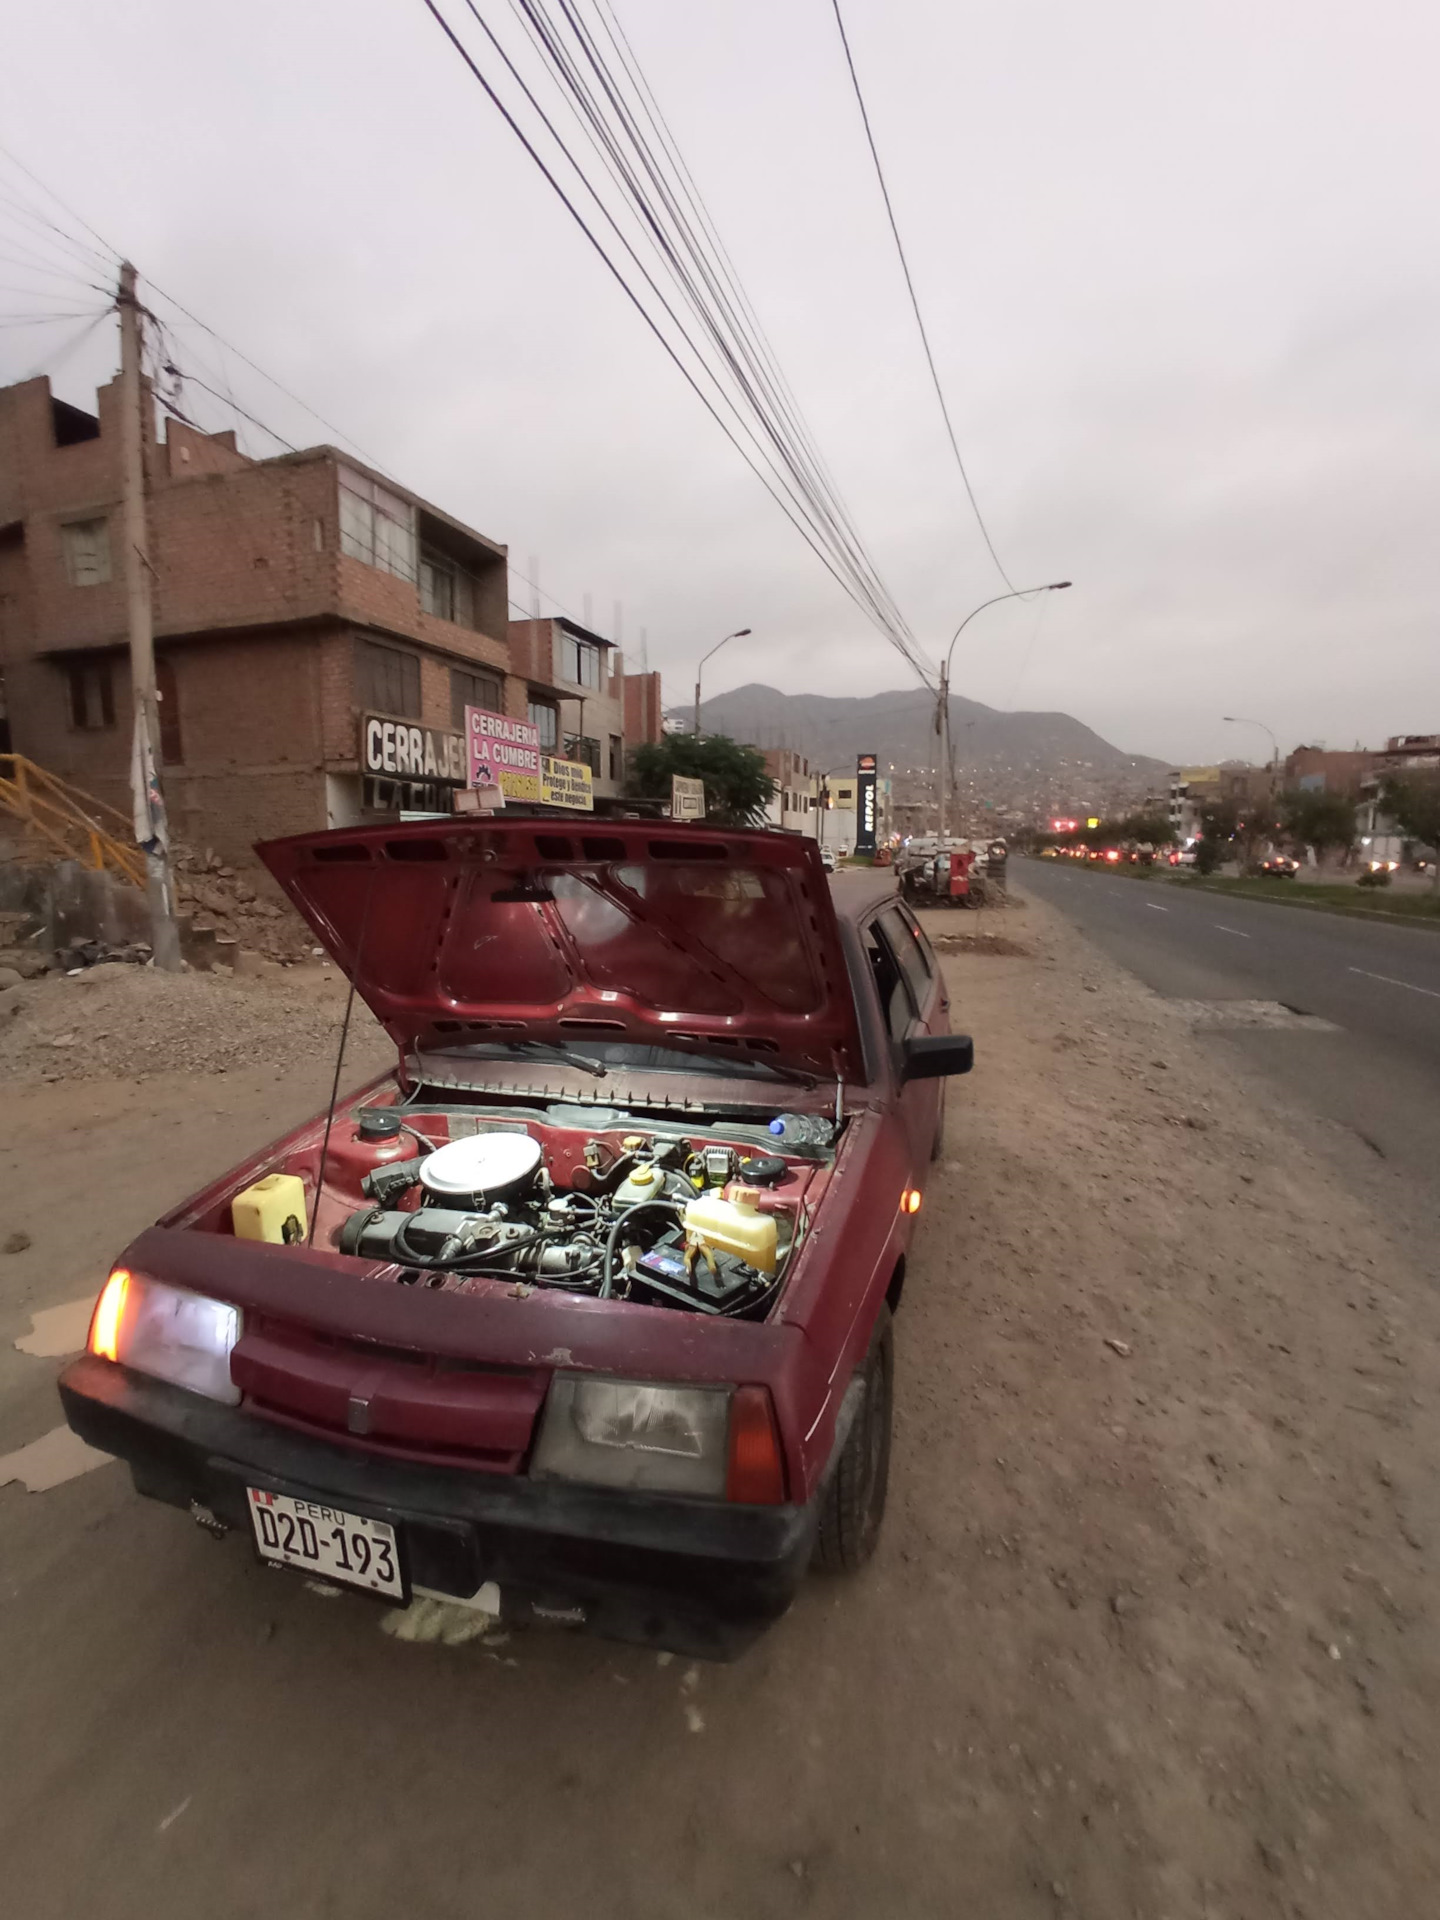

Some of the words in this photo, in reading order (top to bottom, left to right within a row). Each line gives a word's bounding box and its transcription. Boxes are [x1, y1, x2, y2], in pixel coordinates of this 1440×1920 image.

[471, 712, 538, 747] CERRAJERIA
[473, 738, 490, 761] LA
[492, 743, 537, 770] CUMBRE
[864, 784, 875, 832] REPSOL
[294, 1500, 346, 1526] PERU
[256, 1505, 395, 1583] D2D-193
